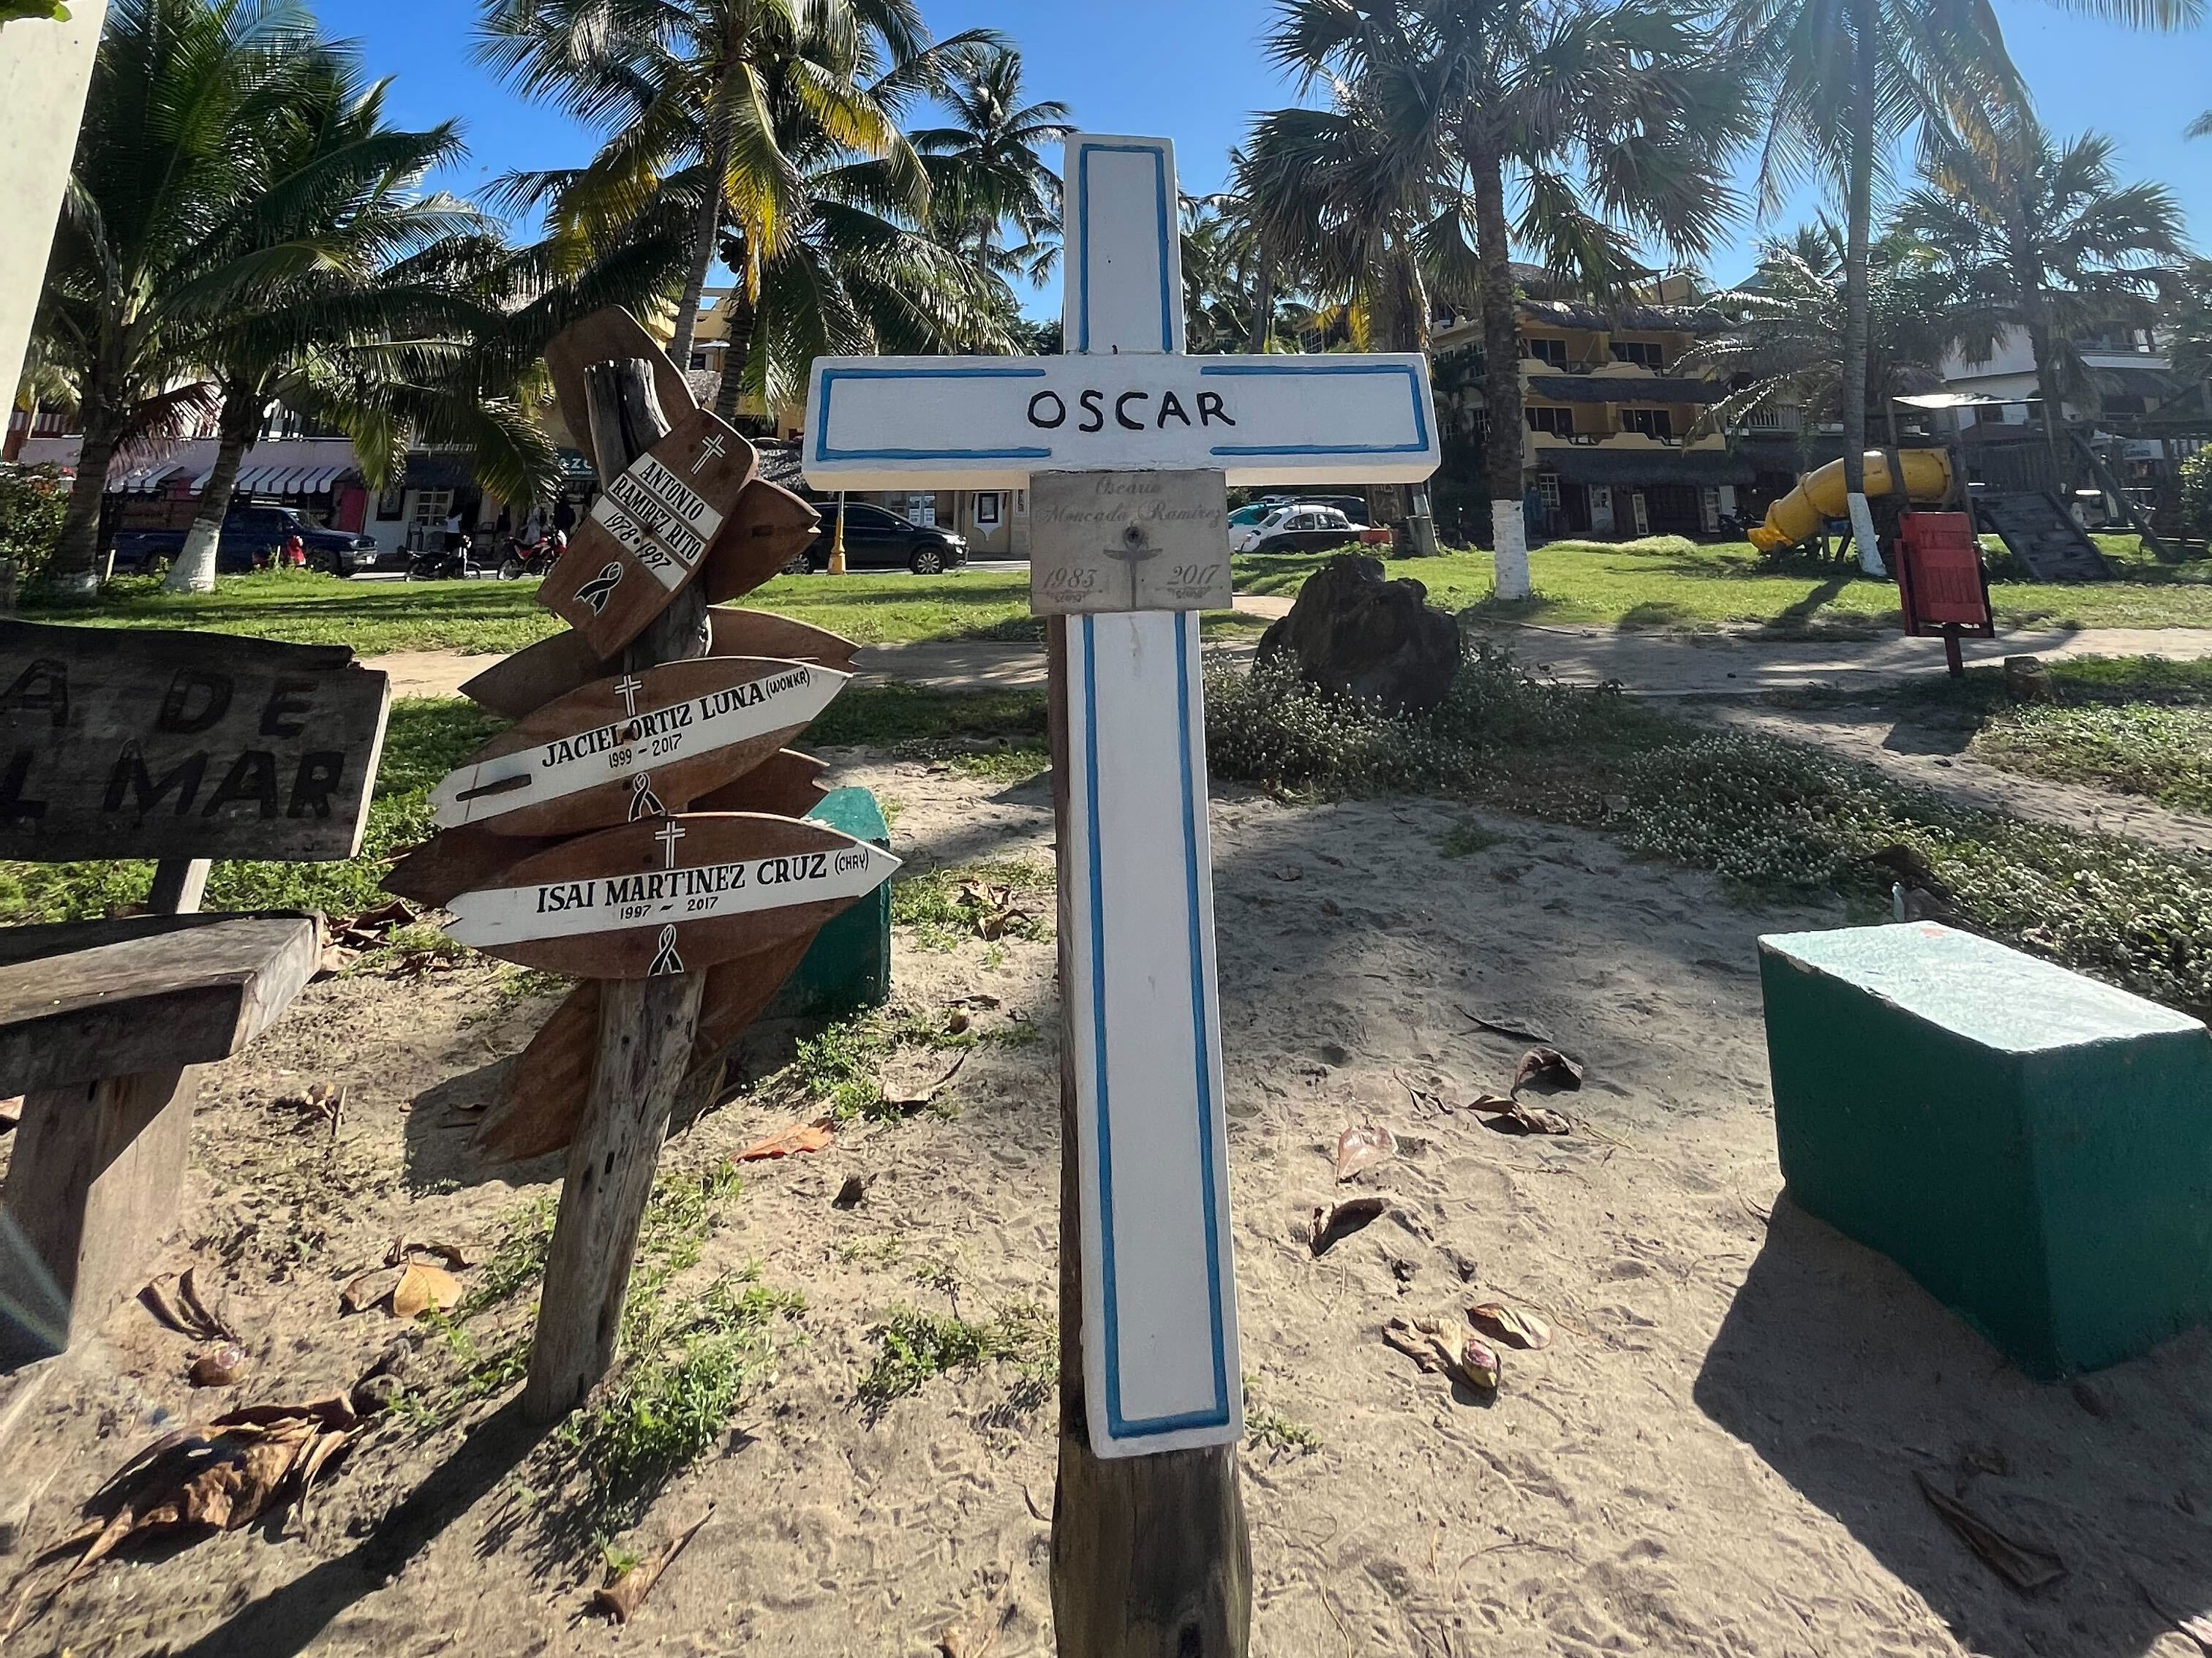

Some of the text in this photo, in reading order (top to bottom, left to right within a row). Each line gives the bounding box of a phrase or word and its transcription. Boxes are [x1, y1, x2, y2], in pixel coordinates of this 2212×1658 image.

[1028, 390, 1236, 432] OSCAR
[612, 475, 702, 560] RAMIREZ RITO
[639, 461, 704, 521] ANTONIO
[1167, 563, 1222, 585] 2017
[155, 666, 317, 737] DE
[541, 724, 624, 768] JACIEL
[629, 703, 693, 741] ORTIZ
[698, 682, 767, 720] LUNA
[102, 738, 345, 818] MAR
[609, 747, 632, 768] 1999
[652, 734, 682, 756] 2017
[536, 881, 595, 913] ISAI
[605, 864, 746, 906] MARTINEZ
[756, 854, 827, 885] CRUZ
[620, 904, 652, 920] 1997
[686, 896, 719, 913] 2017
